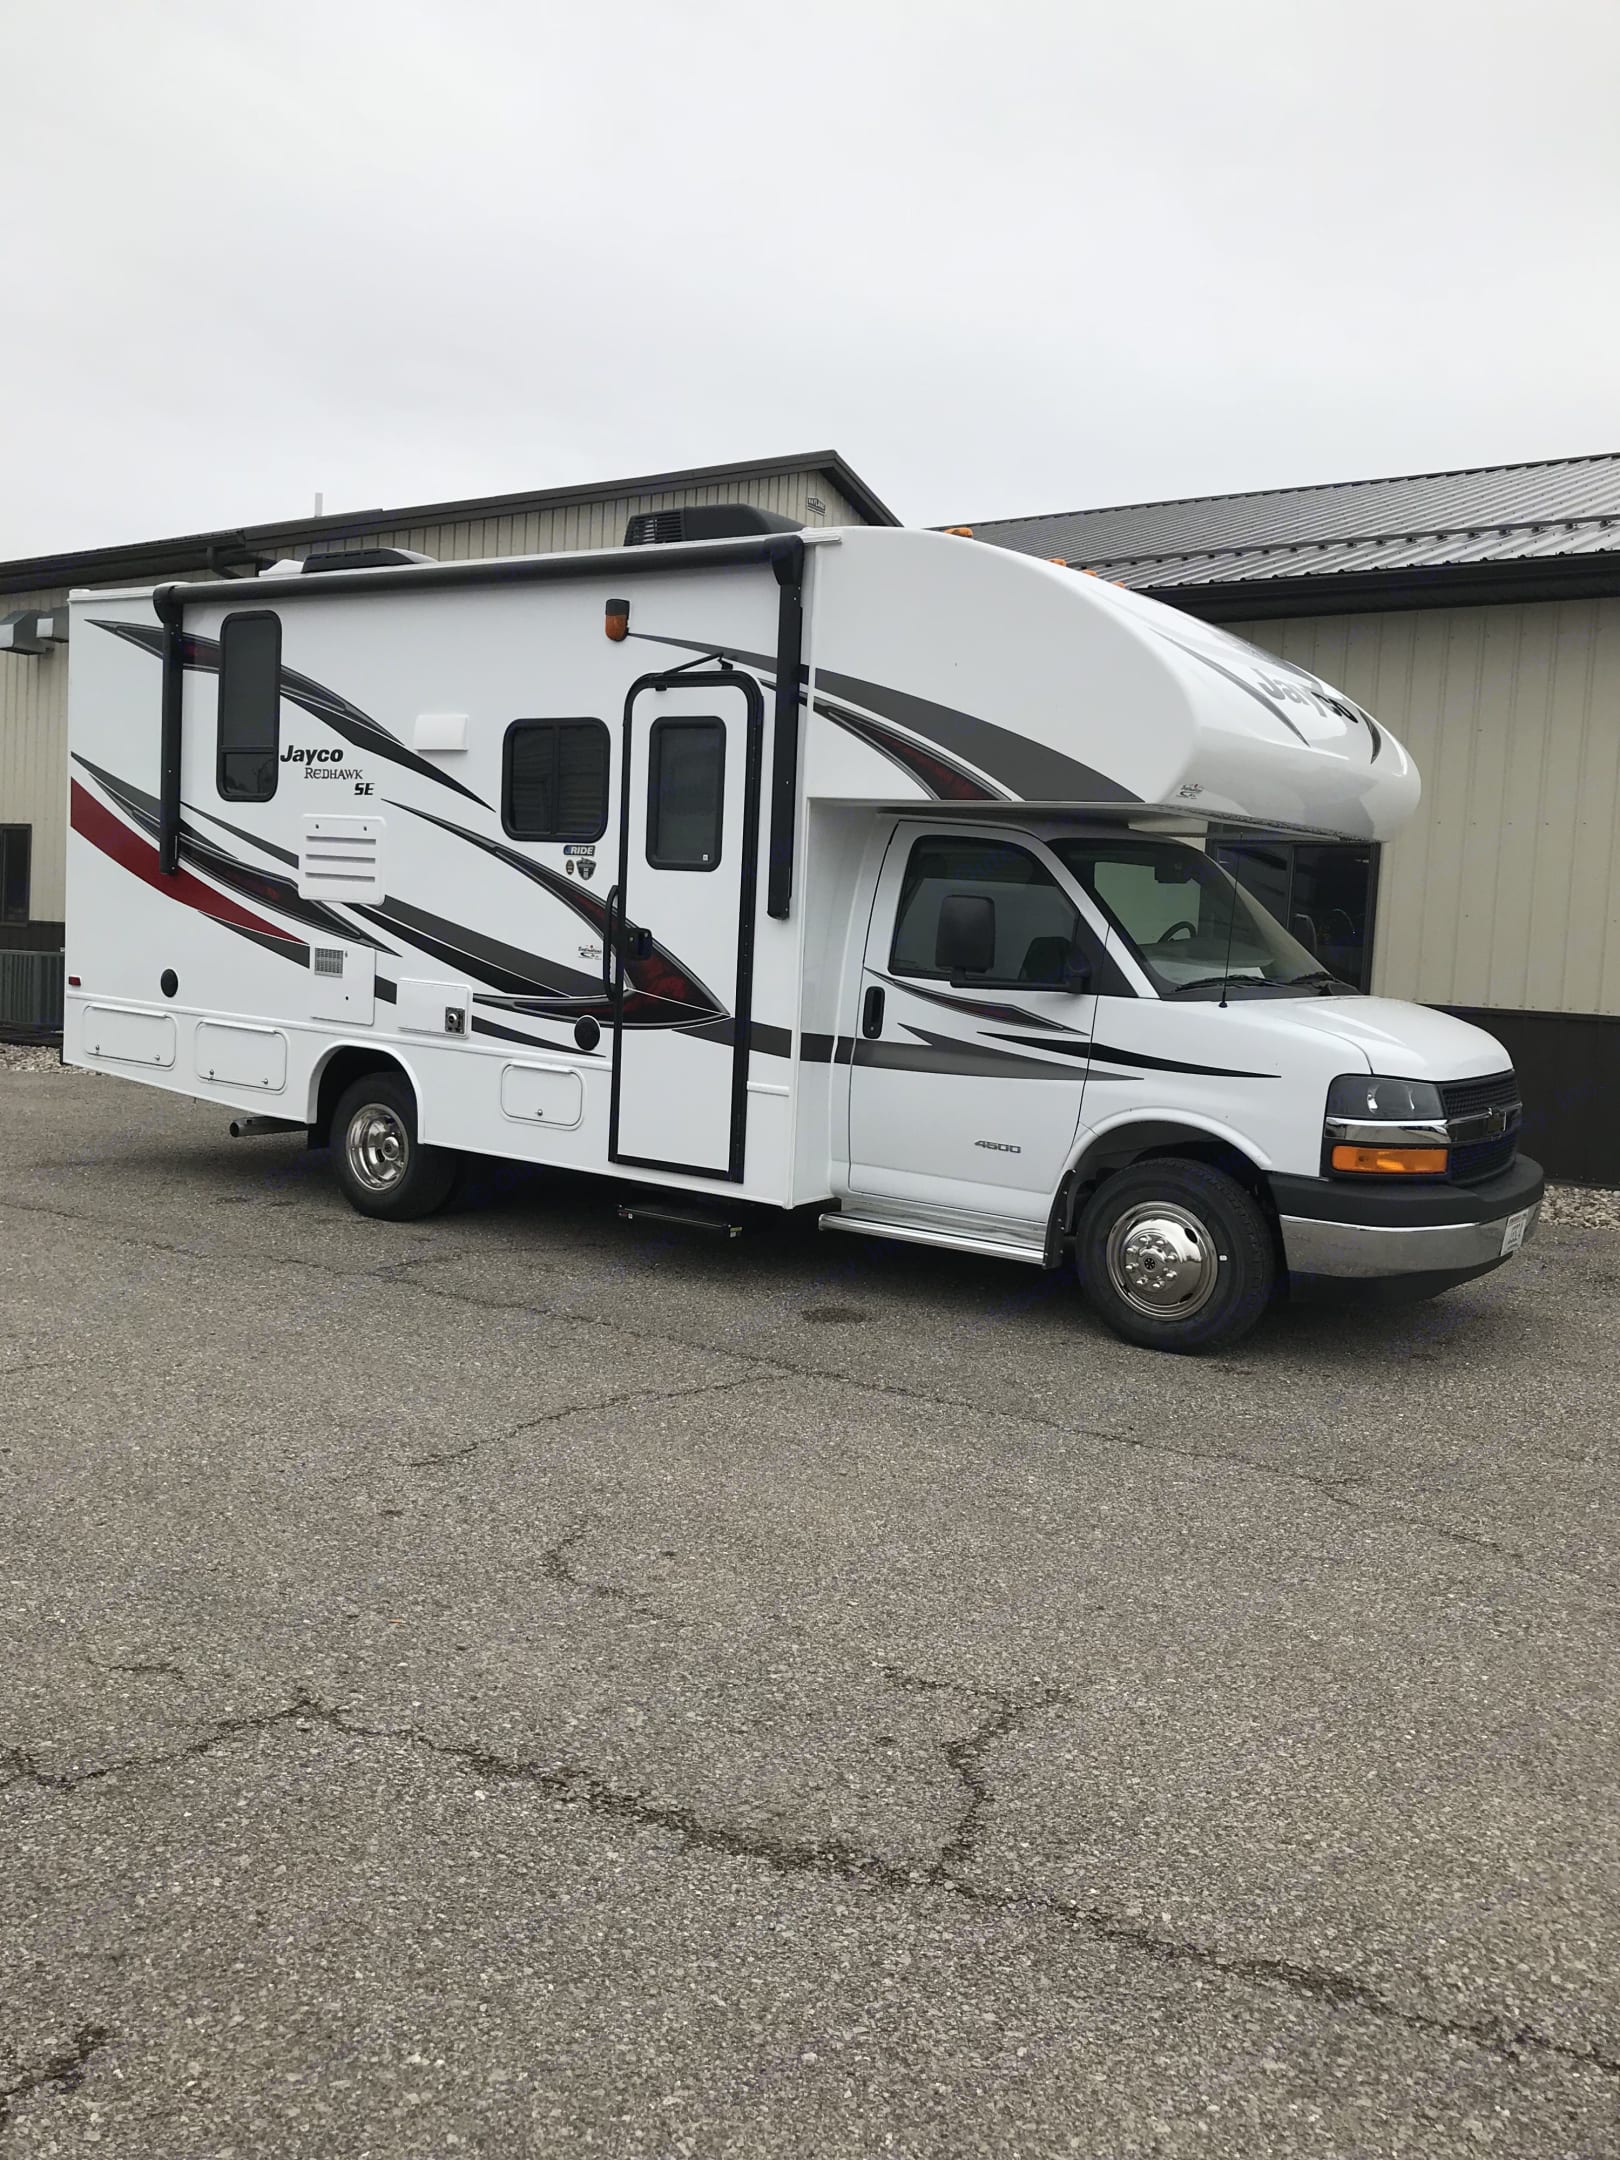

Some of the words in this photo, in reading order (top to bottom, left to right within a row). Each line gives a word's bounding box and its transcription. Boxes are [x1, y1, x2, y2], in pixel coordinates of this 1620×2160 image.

[280, 745, 344, 766] Jayco
[354, 783, 375, 795] SE
[974, 1140, 1021, 1153] 4500
